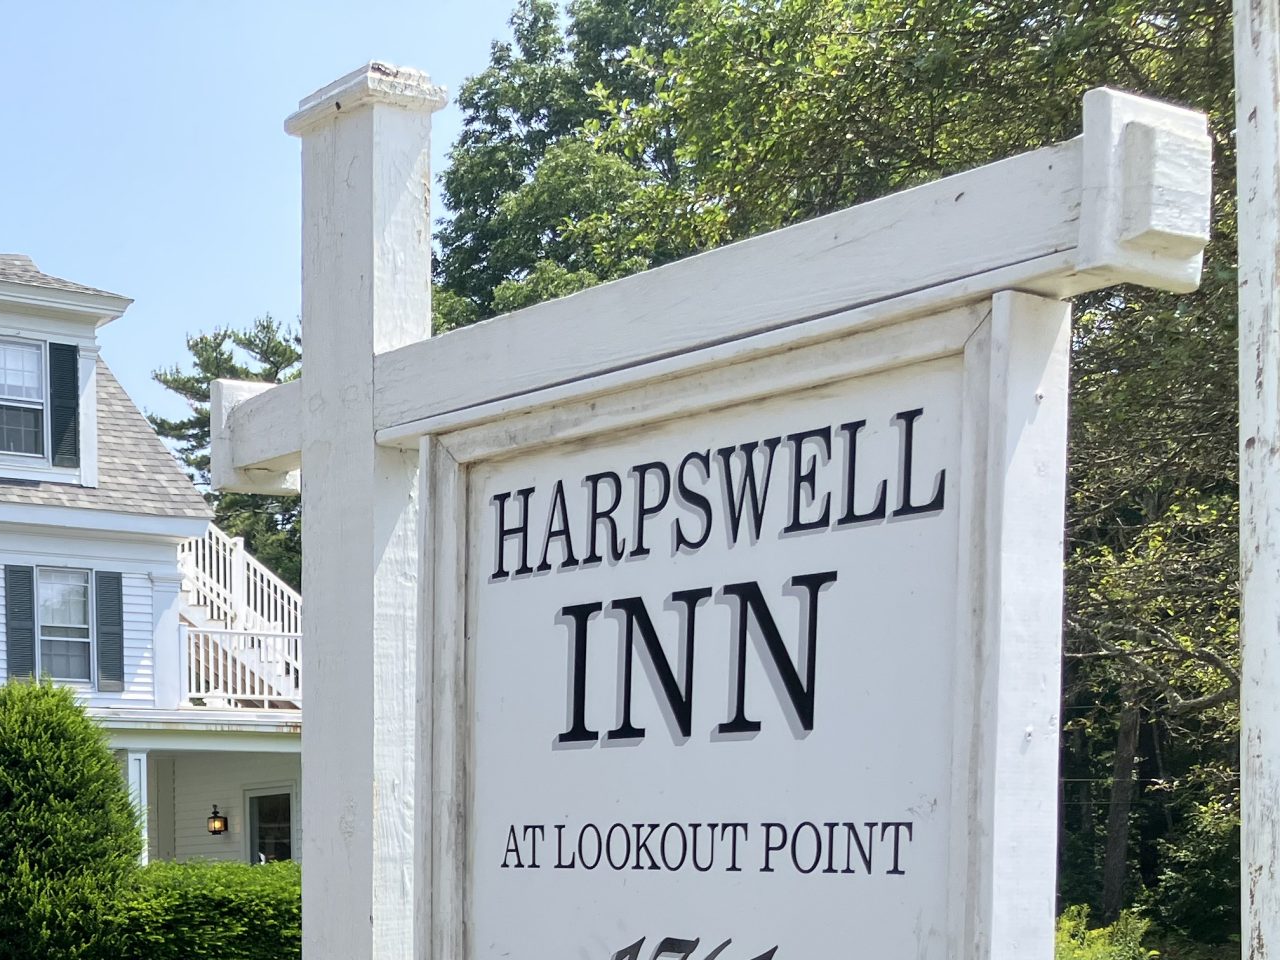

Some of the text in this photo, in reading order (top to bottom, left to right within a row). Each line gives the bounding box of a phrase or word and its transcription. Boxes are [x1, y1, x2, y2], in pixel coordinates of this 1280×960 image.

[490, 407, 946, 581] HARPSWELL
[556, 571, 838, 744] INN
[500, 821, 913, 876] AT LOOKOUT POINT
